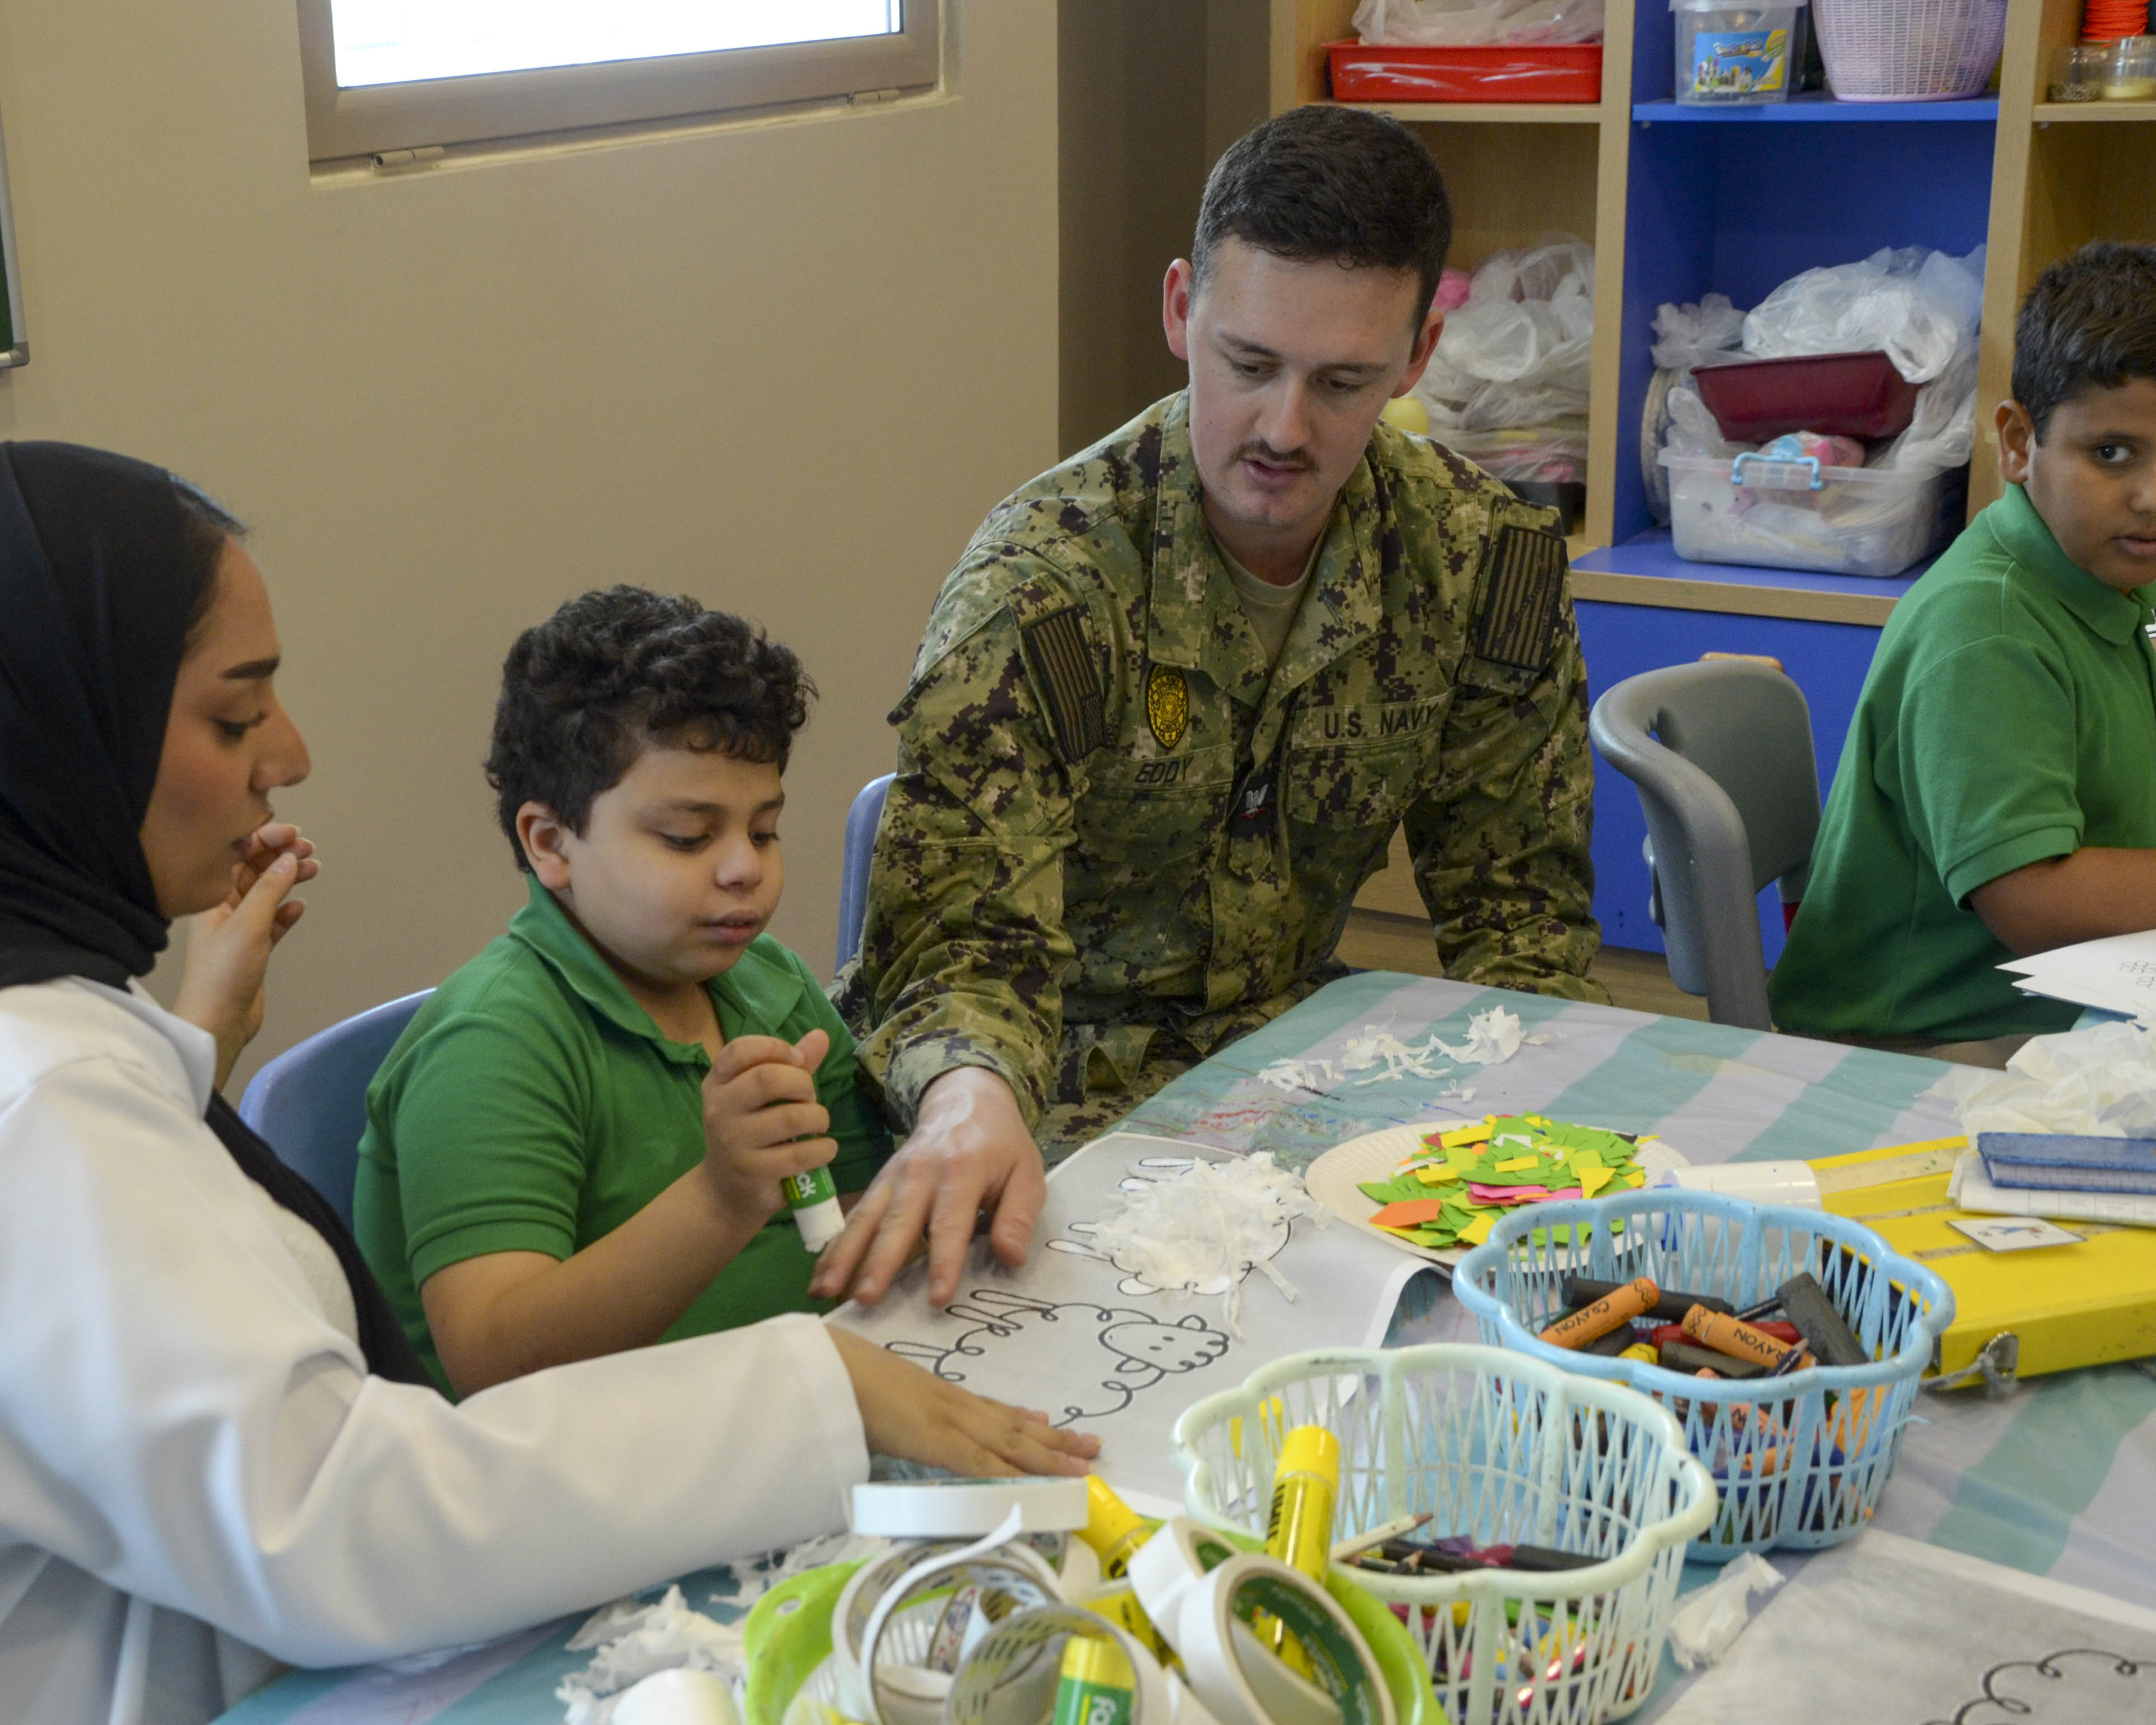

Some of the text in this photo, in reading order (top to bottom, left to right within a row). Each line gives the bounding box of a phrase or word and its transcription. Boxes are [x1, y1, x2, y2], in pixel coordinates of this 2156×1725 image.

[1324, 703, 1439, 739] U.S. NAVY
[1134, 754, 1194, 783] EDDY
[1555, 1300, 1610, 1336] CRAYON
[1733, 1328, 1783, 1361] RAYON
